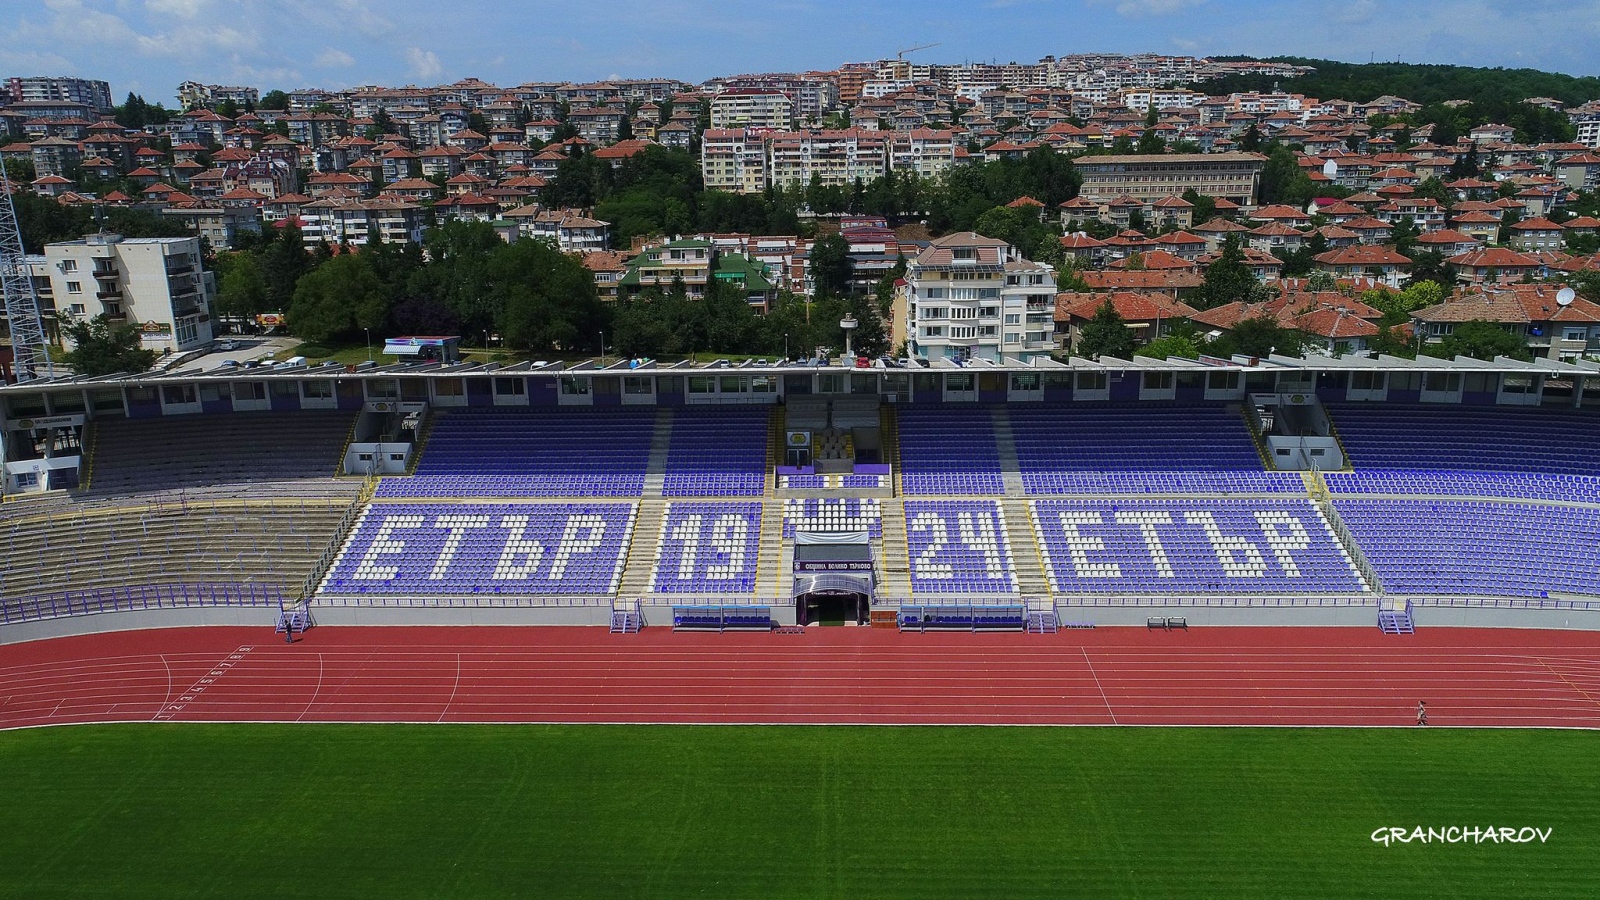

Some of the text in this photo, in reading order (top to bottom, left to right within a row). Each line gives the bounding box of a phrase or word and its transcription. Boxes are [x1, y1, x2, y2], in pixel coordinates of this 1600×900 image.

[353, 511, 1311, 580] ЕТЪР 19 24 ЕТЪР
